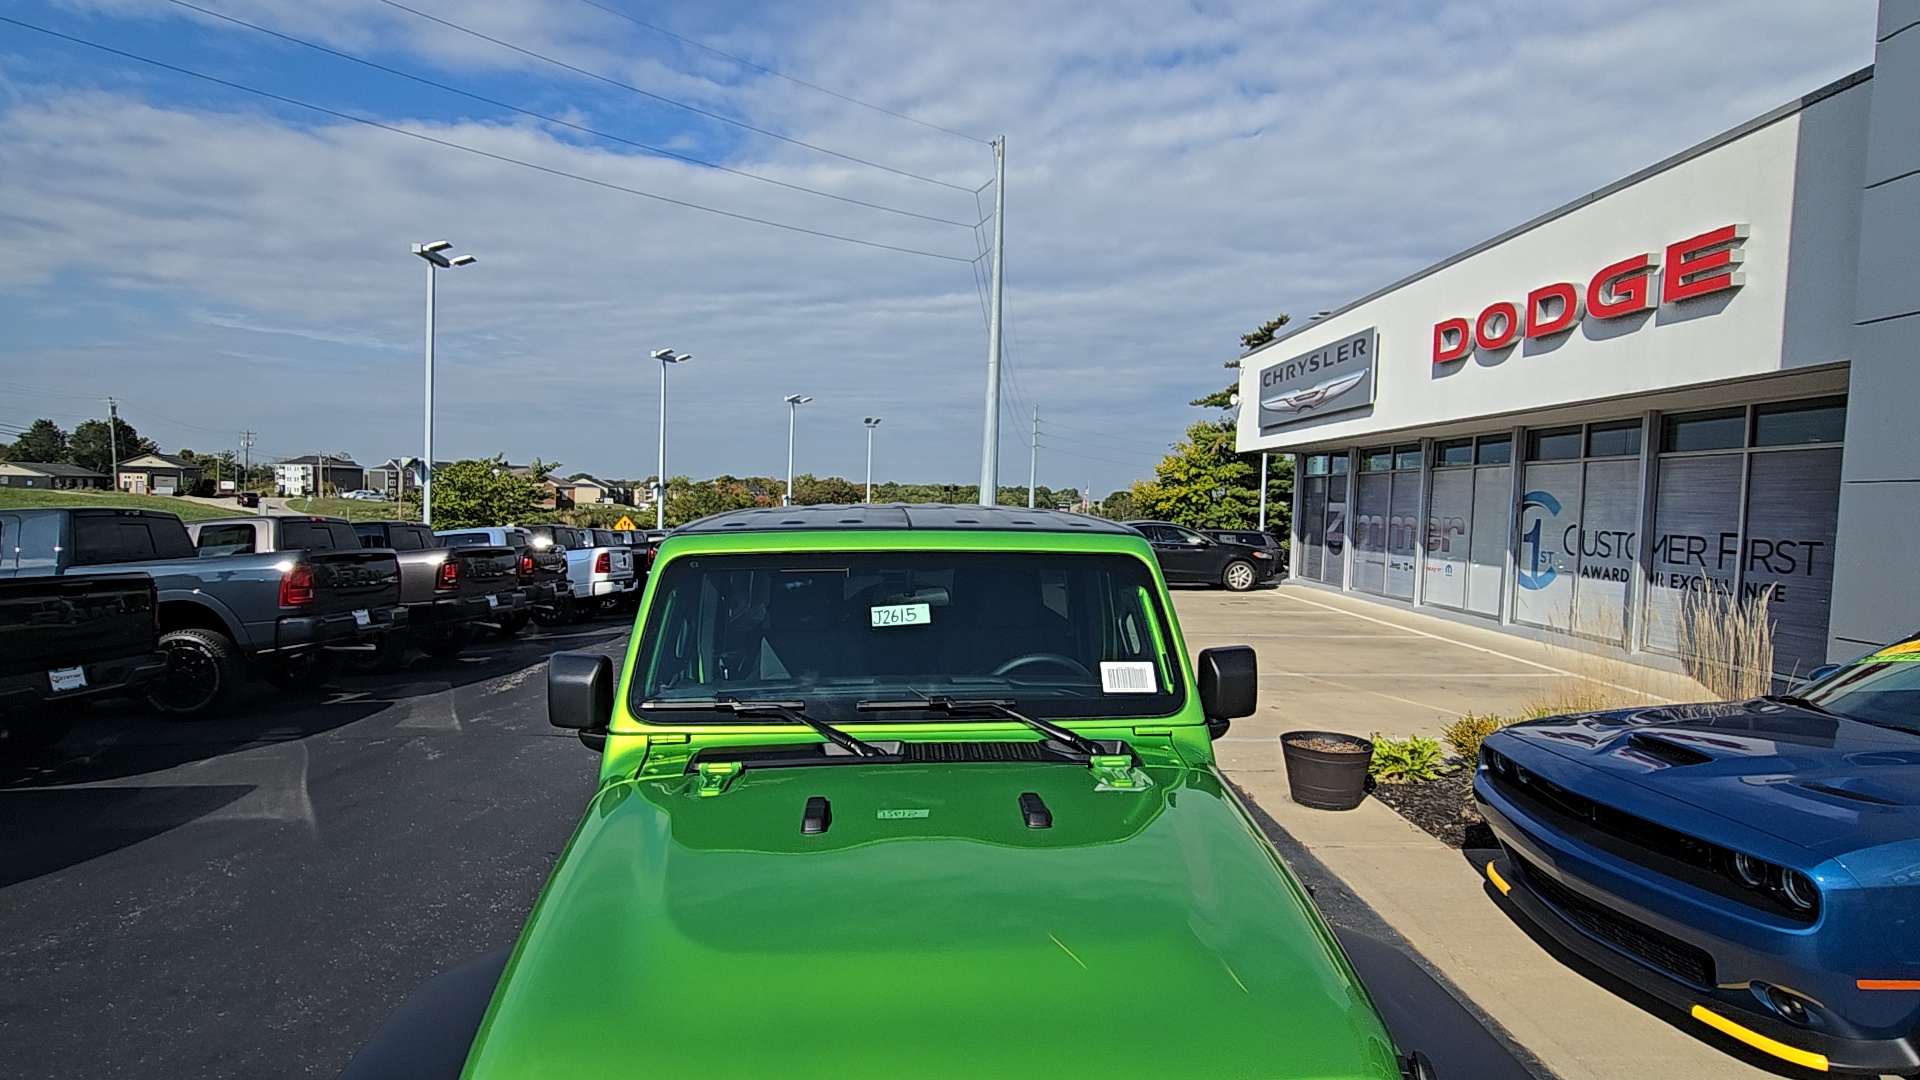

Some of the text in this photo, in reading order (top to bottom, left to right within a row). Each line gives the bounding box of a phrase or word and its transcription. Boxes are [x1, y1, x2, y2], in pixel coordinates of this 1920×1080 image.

[1433, 223, 1748, 363] DODGE
[1262, 337, 1367, 388] CHRYSLER
[1326, 501, 1465, 553] Zmmer
[1581, 564, 1630, 583] AWARD
[1717, 532, 1825, 577] FIRST
[873, 607, 917, 625] J2615
